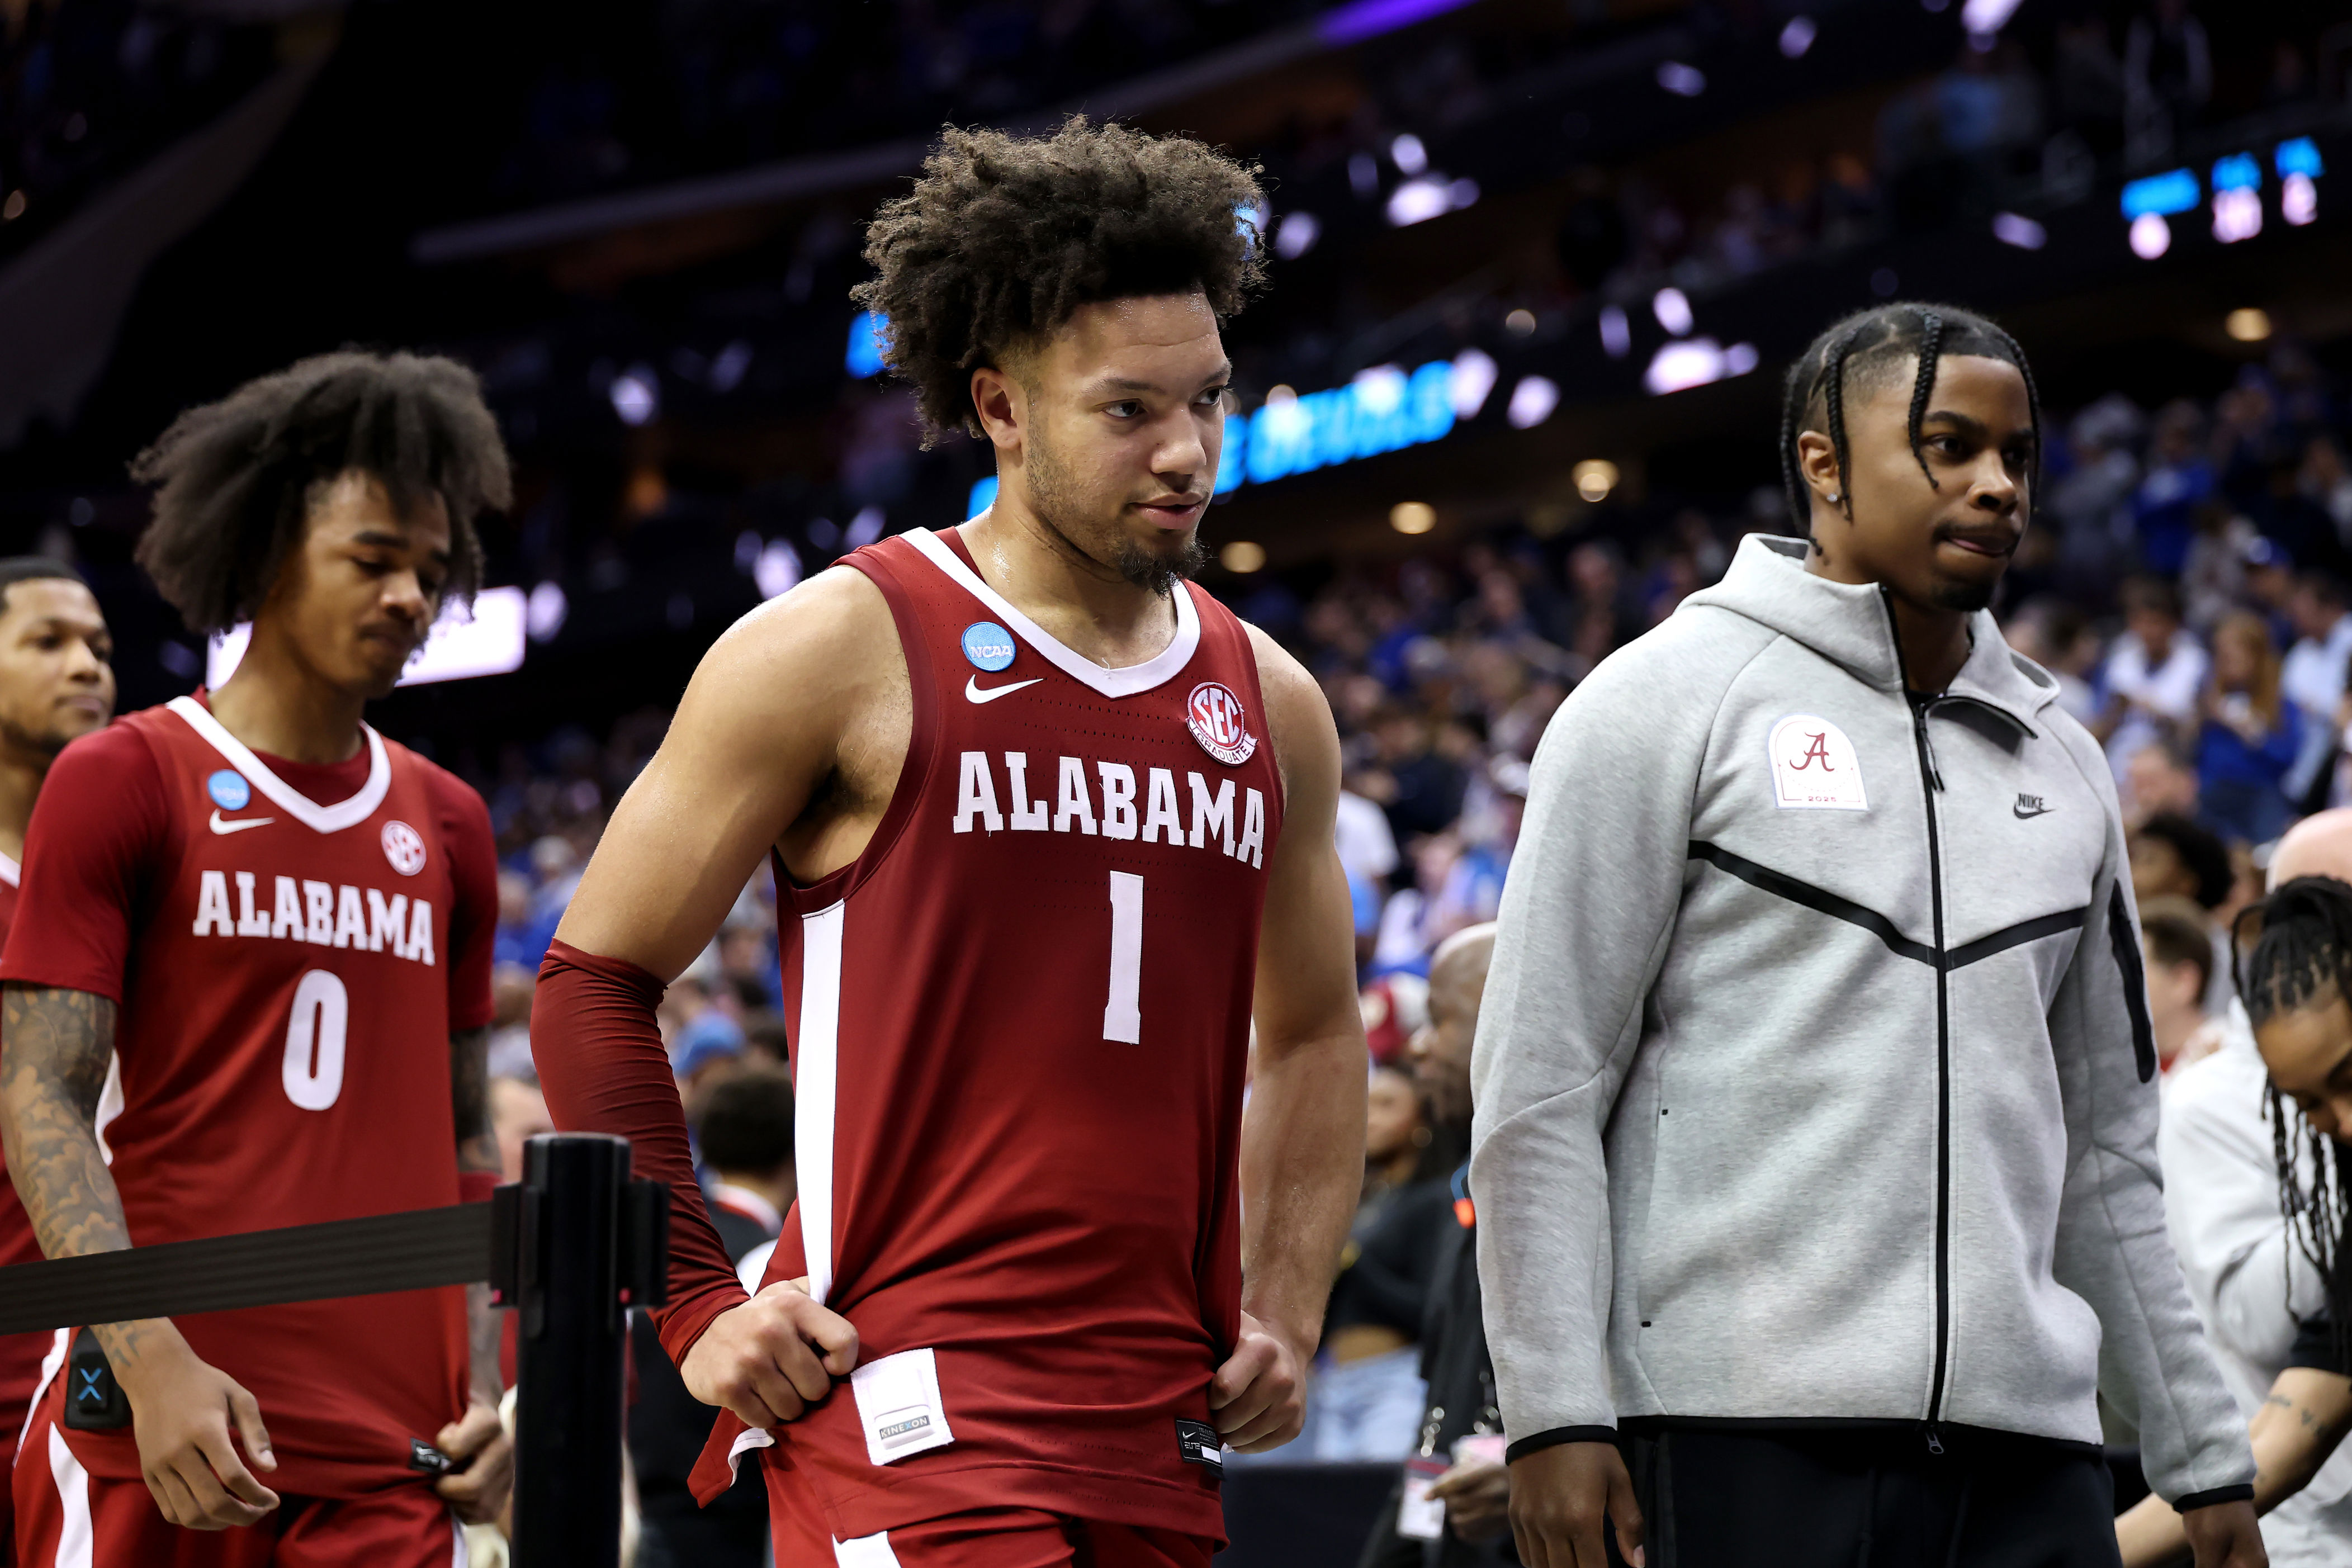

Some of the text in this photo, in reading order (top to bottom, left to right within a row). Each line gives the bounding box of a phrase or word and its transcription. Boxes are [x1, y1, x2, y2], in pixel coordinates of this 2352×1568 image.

[971, 645, 1013, 658] NCAA
[1194, 688, 1239, 743] SEC
[1197, 732, 1250, 762] GRADUATE
[953, 751, 1263, 870] ALABAMA
[2018, 793, 2043, 809] NIKE
[192, 870, 436, 966] ALABAMA
[1103, 870, 1144, 1045] 1
[281, 968, 348, 1111] 0
[880, 1417, 928, 1438] KINEXON
